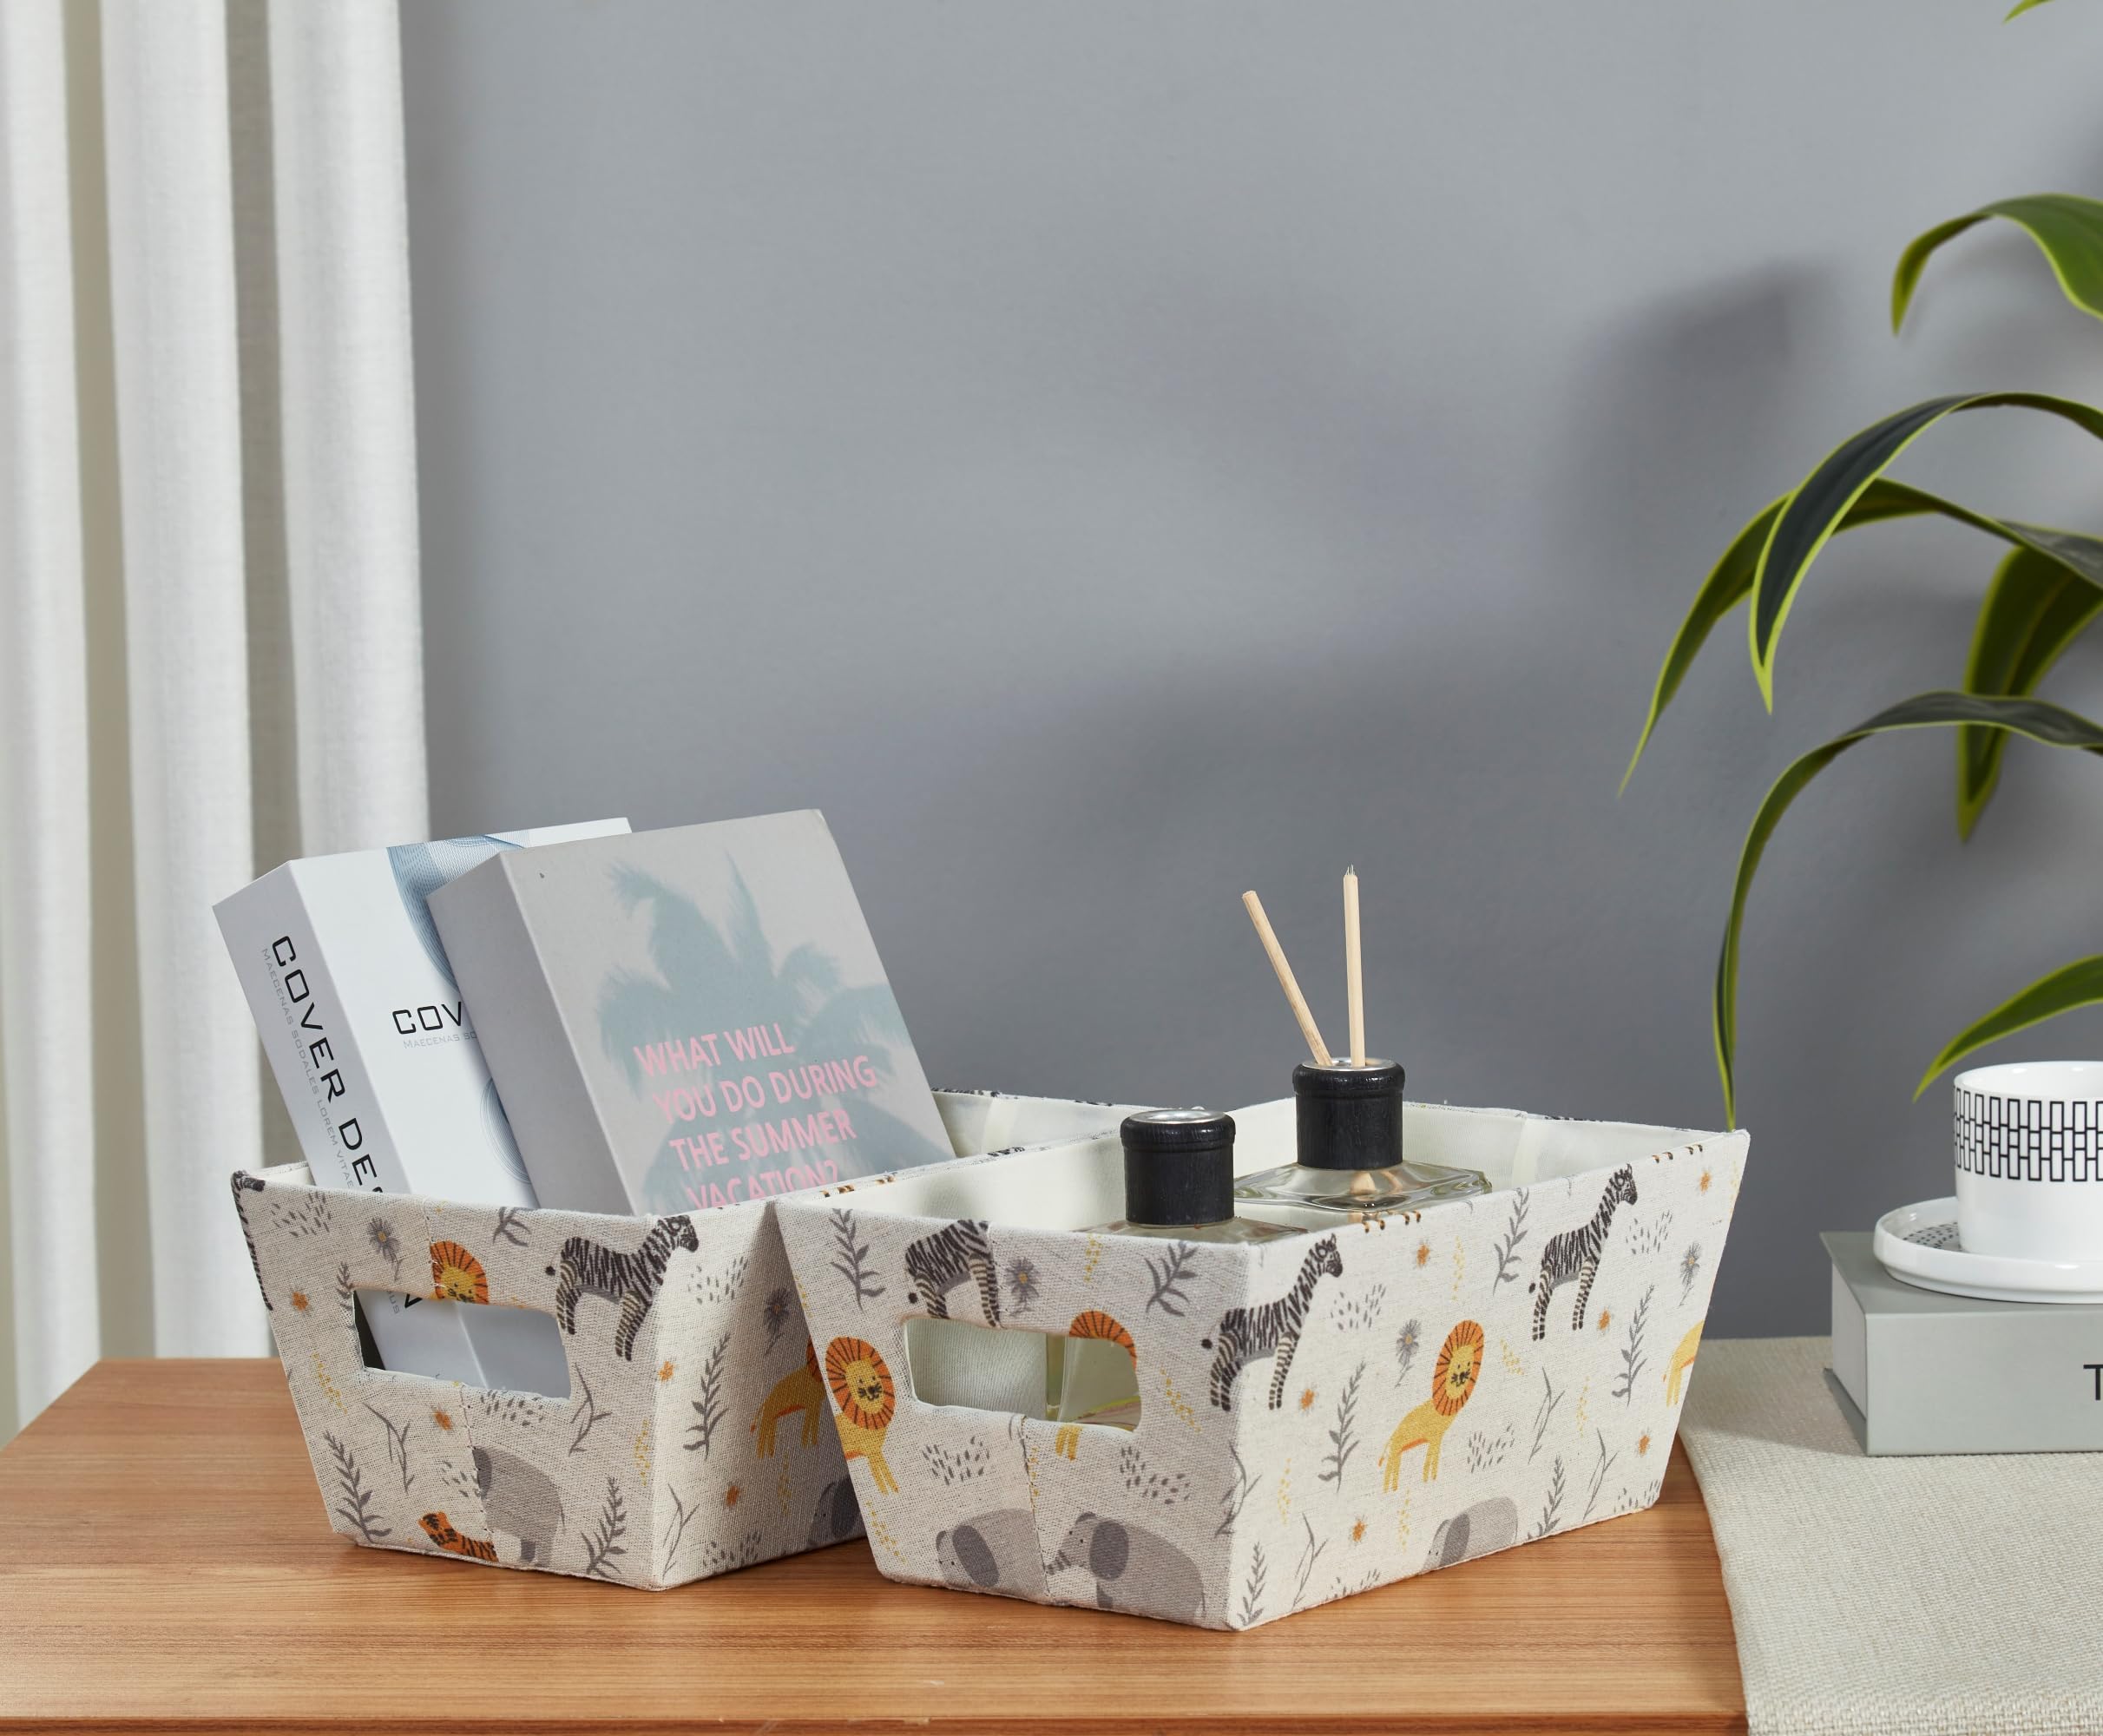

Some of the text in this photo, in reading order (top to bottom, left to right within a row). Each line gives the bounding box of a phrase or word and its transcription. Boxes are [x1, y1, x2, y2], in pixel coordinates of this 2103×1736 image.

[261, 948, 293, 1025] MAECENAS
[292, 1029, 319, 1095] SODALES
[317, 1099, 338, 1146] LOREM
[273, 936, 383, 1193] COVER DE
[403, 1034, 460, 1049] MAECENAS
[634, 1023, 795, 1076] WHAT WILL
[653, 1055, 877, 1124] YOU DO DURING
[668, 1108, 858, 1171] THE SUMMER
